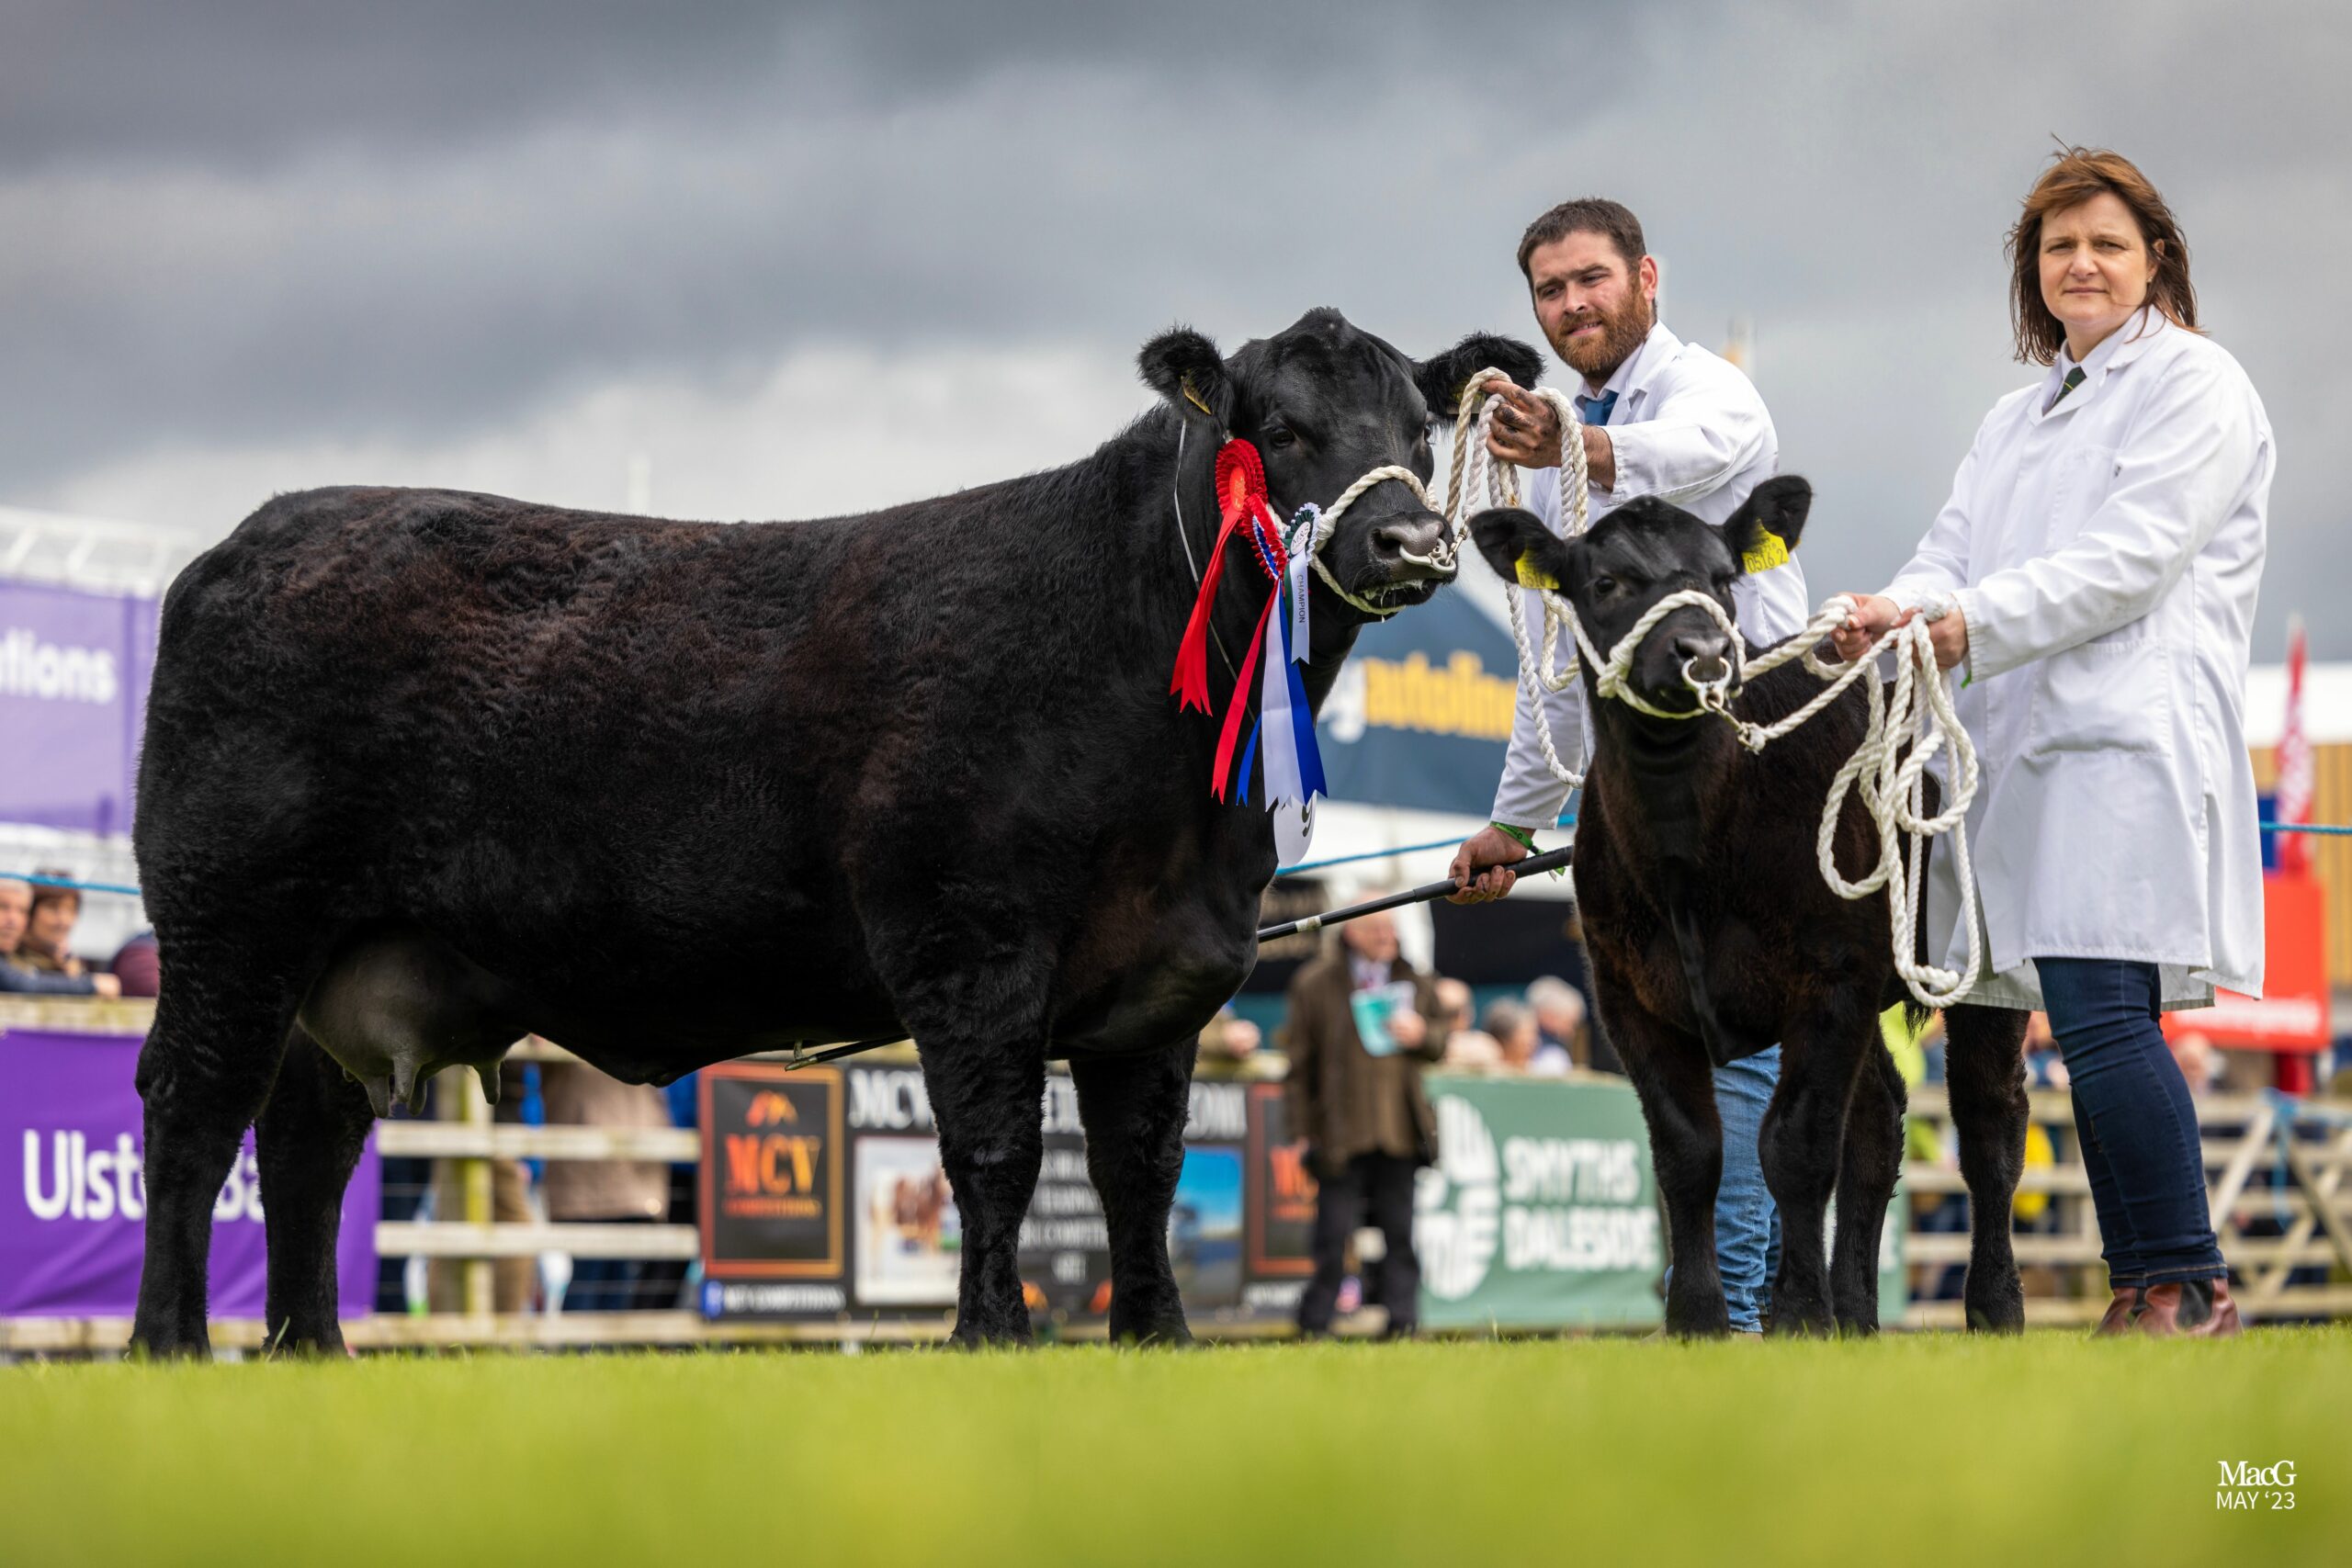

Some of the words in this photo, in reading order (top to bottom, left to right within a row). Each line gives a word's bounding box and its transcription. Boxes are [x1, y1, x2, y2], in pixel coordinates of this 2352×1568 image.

[1296, 574, 1306, 624] CHAMPION
[0, 625, 117, 705] tions
[24, 1129, 146, 1220] Ulst
[725, 1134, 820, 1194] MCV
[1503, 1137, 1640, 1203] SMYTHS
[1504, 1206, 1658, 1271] DALESIDE
